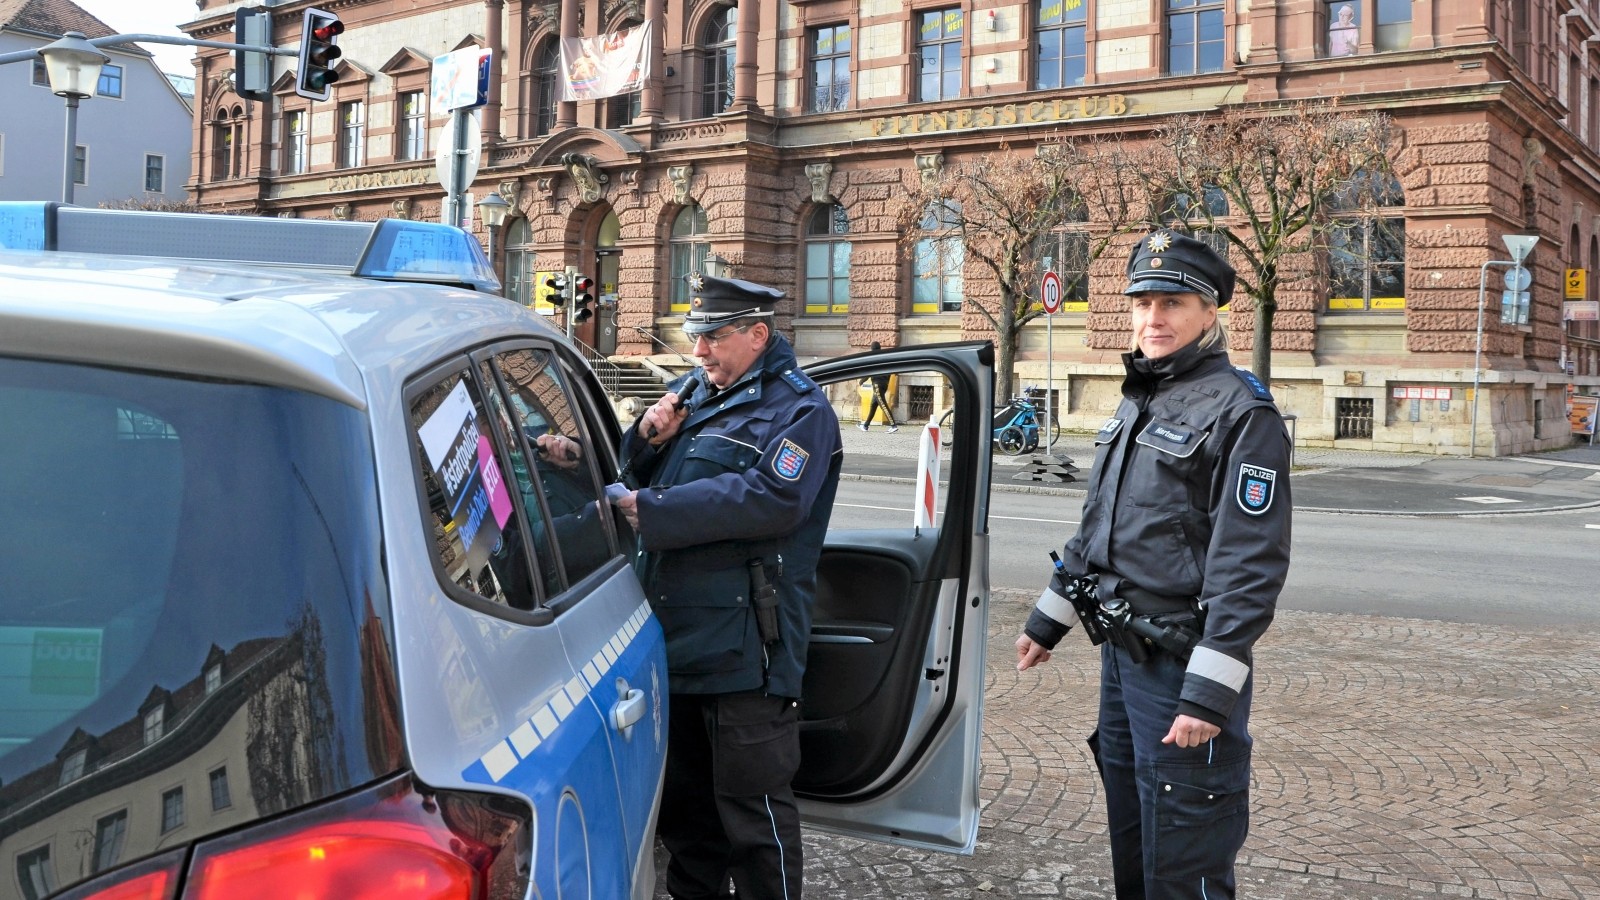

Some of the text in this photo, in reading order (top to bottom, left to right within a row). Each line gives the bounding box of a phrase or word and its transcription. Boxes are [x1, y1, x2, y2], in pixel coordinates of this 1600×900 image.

[870, 93, 1127, 137] FITNESSCLUB
[326, 168, 427, 192] PANORAMA
[1046, 283, 1057, 302] 10
[482, 453, 500, 503] JETZT
[1242, 467, 1274, 481] POLIZEI
